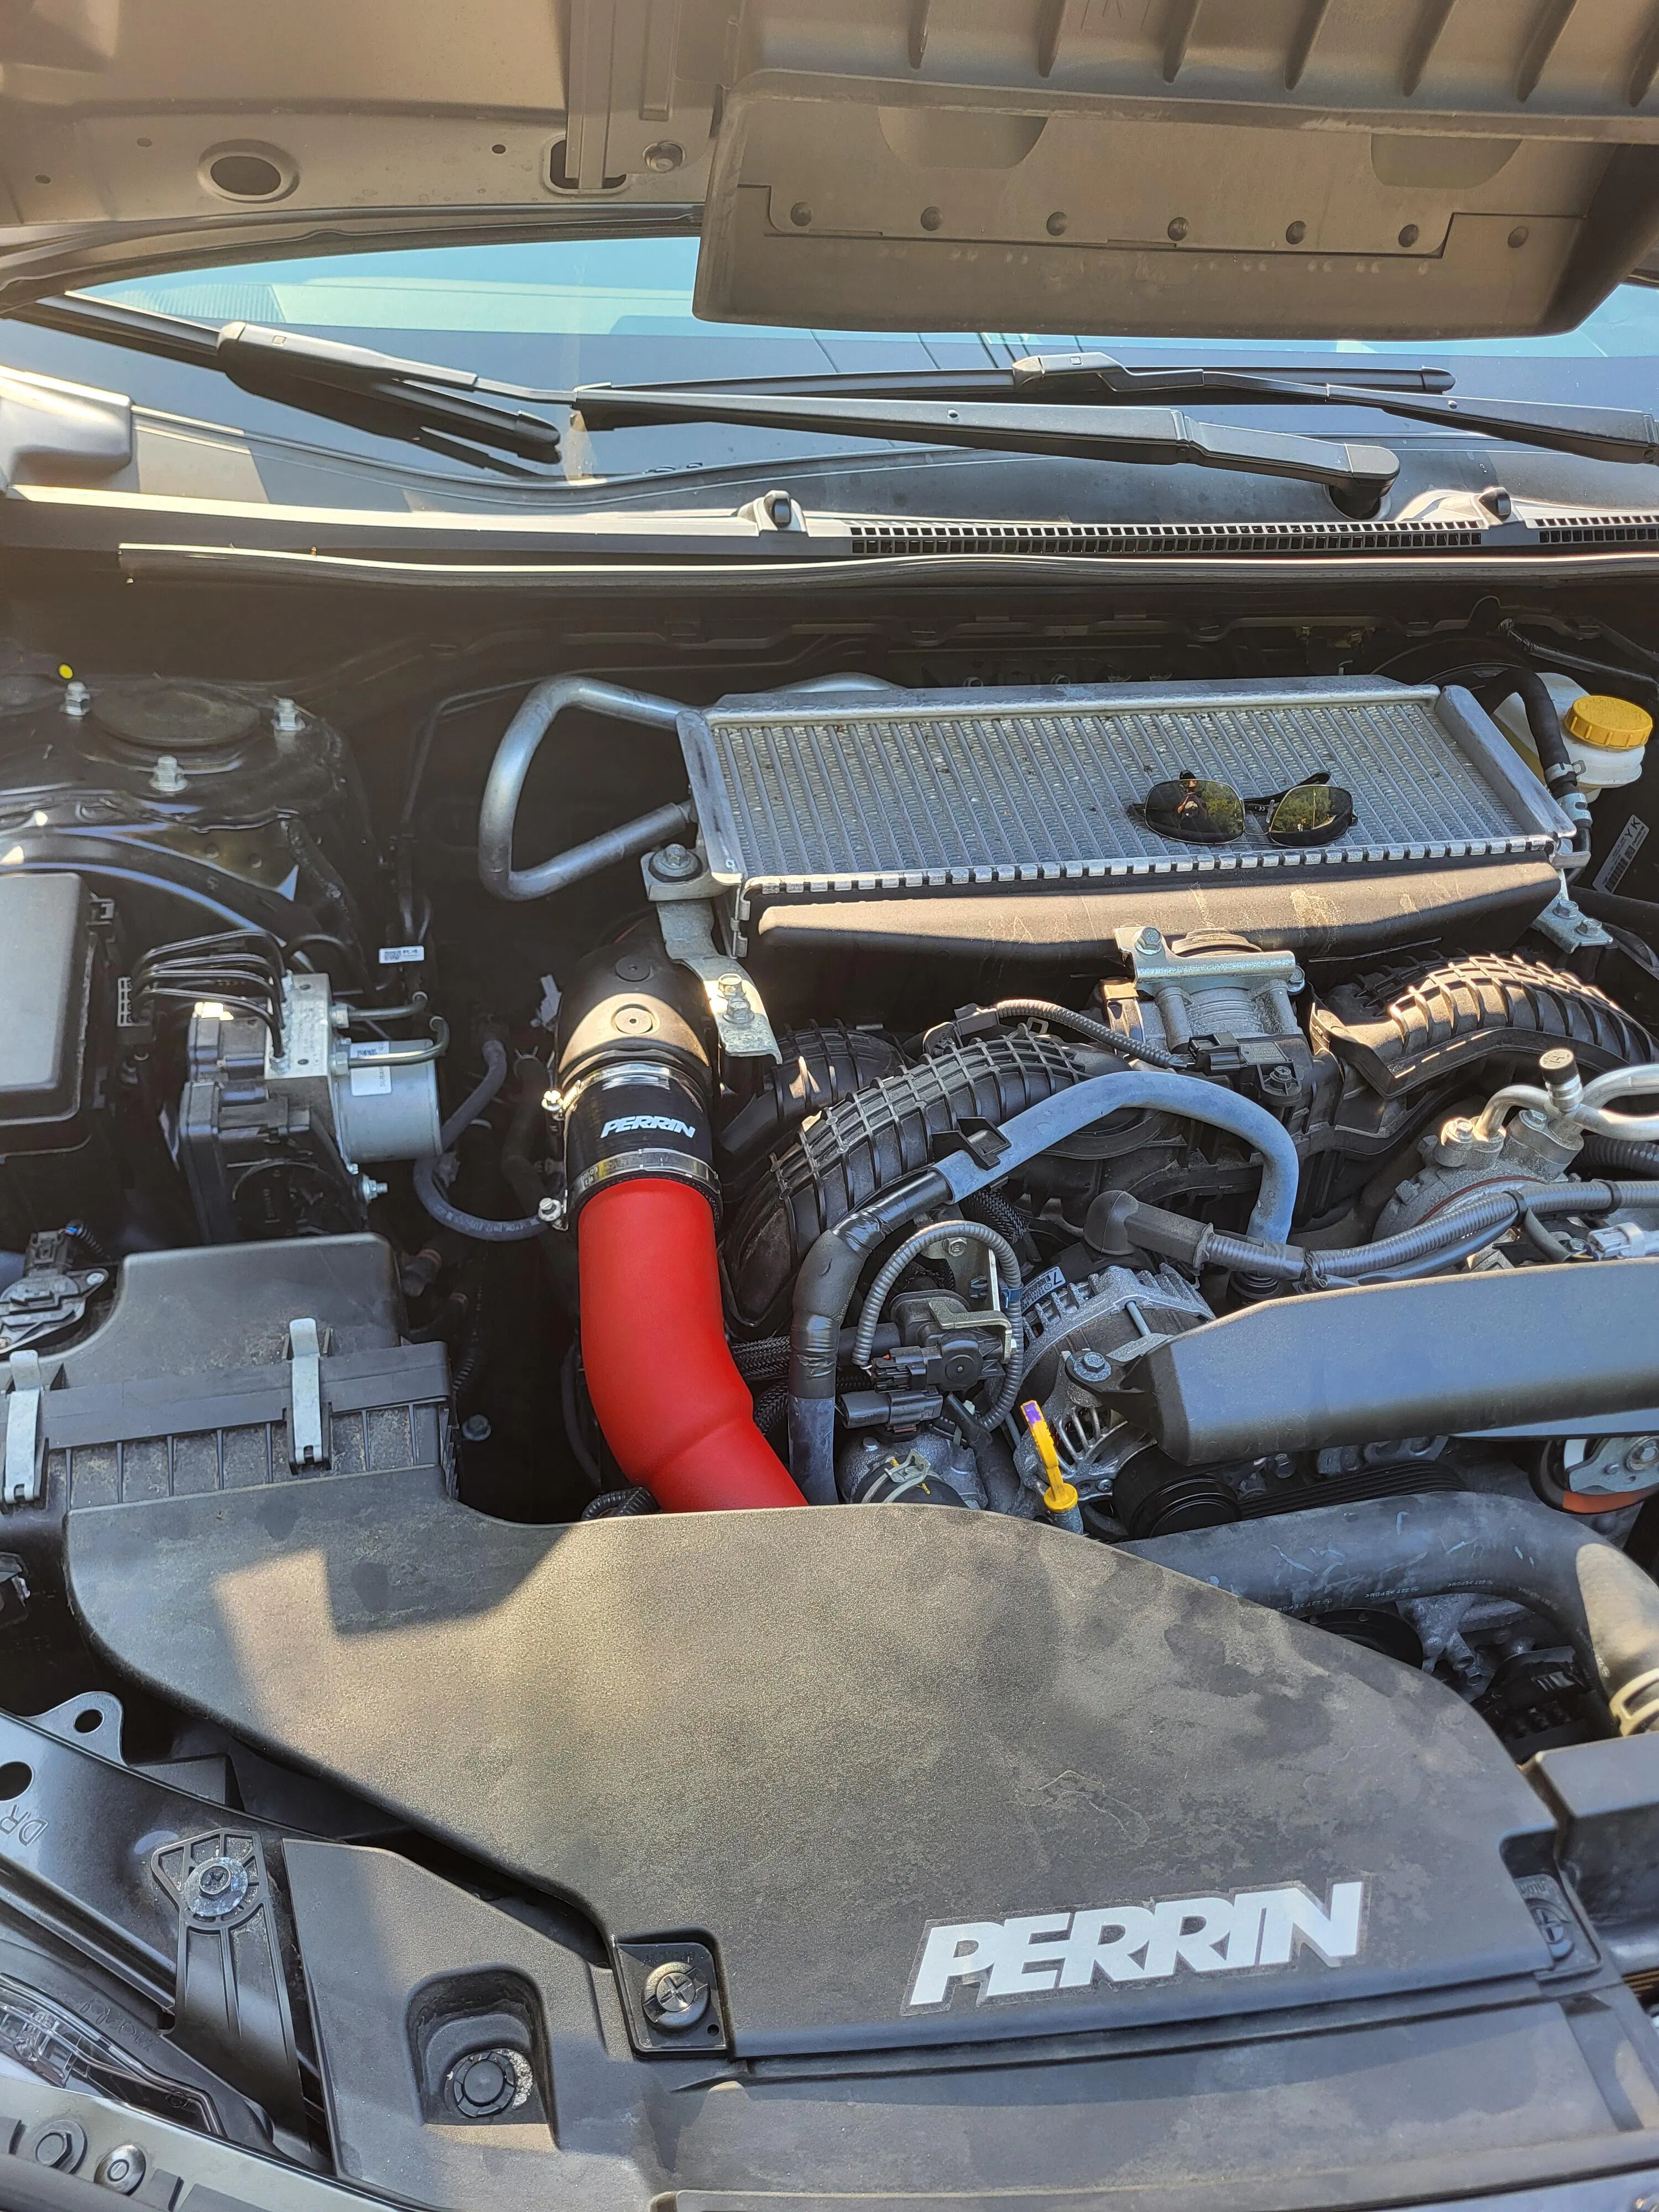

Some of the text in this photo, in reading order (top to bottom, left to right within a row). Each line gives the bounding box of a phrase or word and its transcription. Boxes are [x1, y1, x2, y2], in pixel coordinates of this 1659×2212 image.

[600, 1115, 696, 1138] PERRIN
[1053, 1271, 1062, 1285] 7
[910, 1881, 1362, 2006] PERRIN
